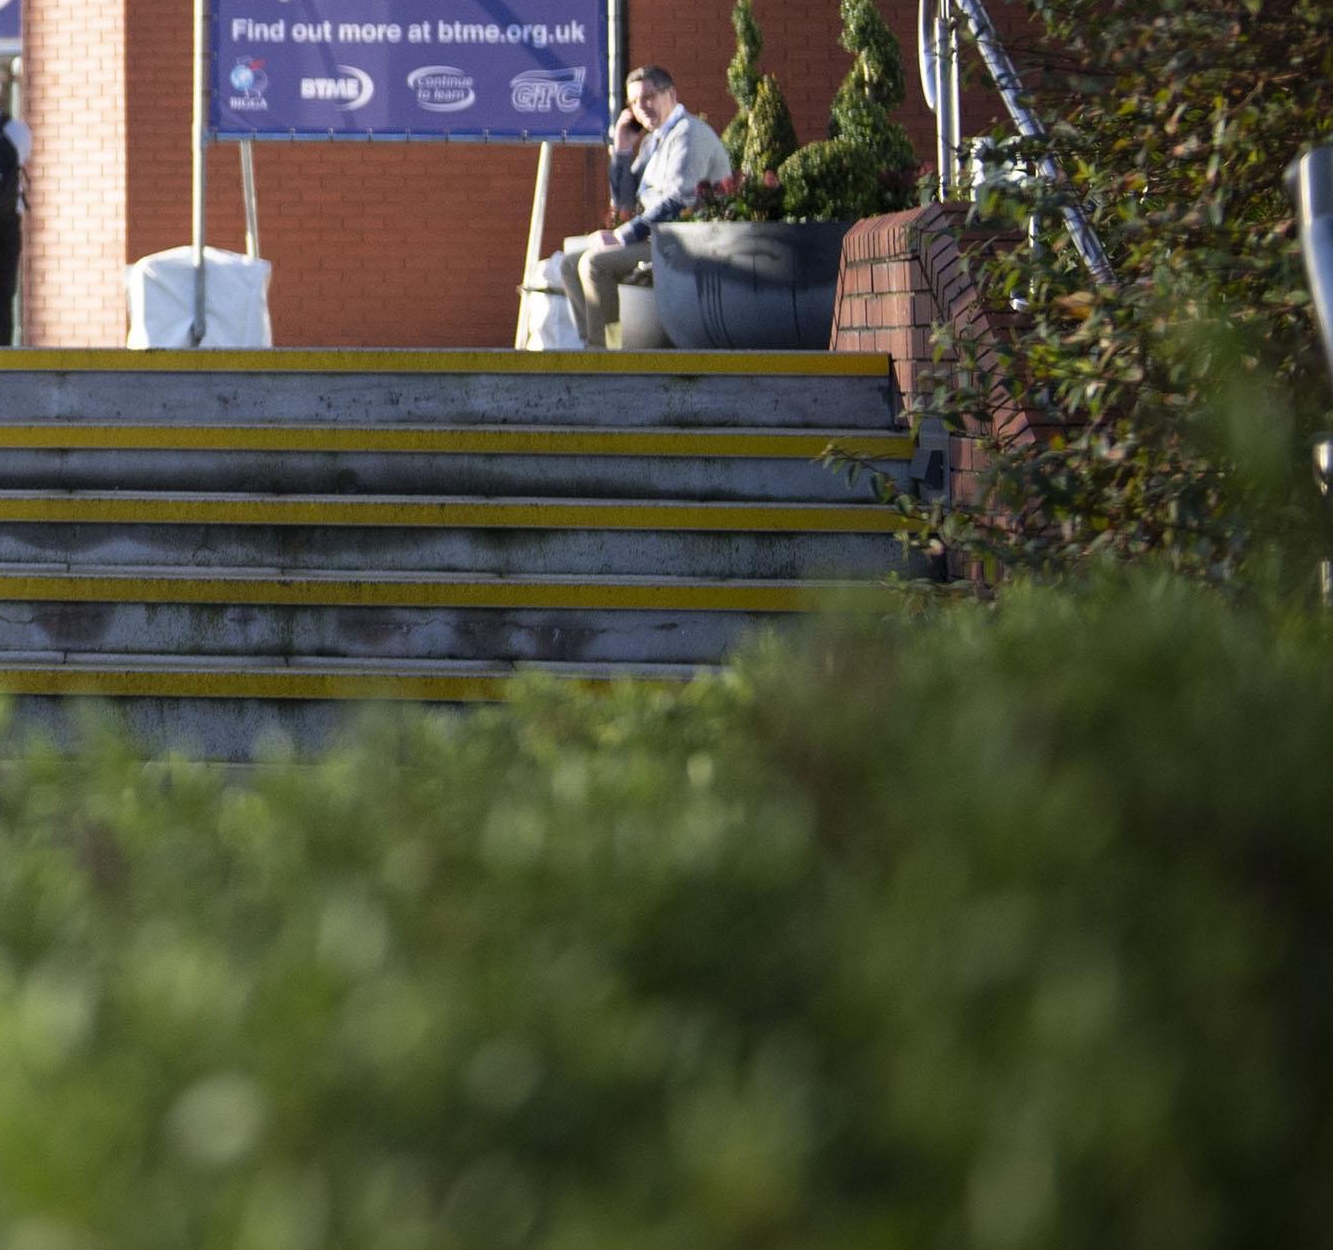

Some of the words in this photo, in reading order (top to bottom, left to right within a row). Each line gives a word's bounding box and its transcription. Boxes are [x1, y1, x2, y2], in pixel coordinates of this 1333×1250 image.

[233, 18, 285, 42] Find
[291, 20, 332, 42] out
[339, 24, 401, 42] more
[408, 20, 431, 42] at
[438, 20, 586, 48] btme.org.uk
[301, 78, 359, 99] BTME
